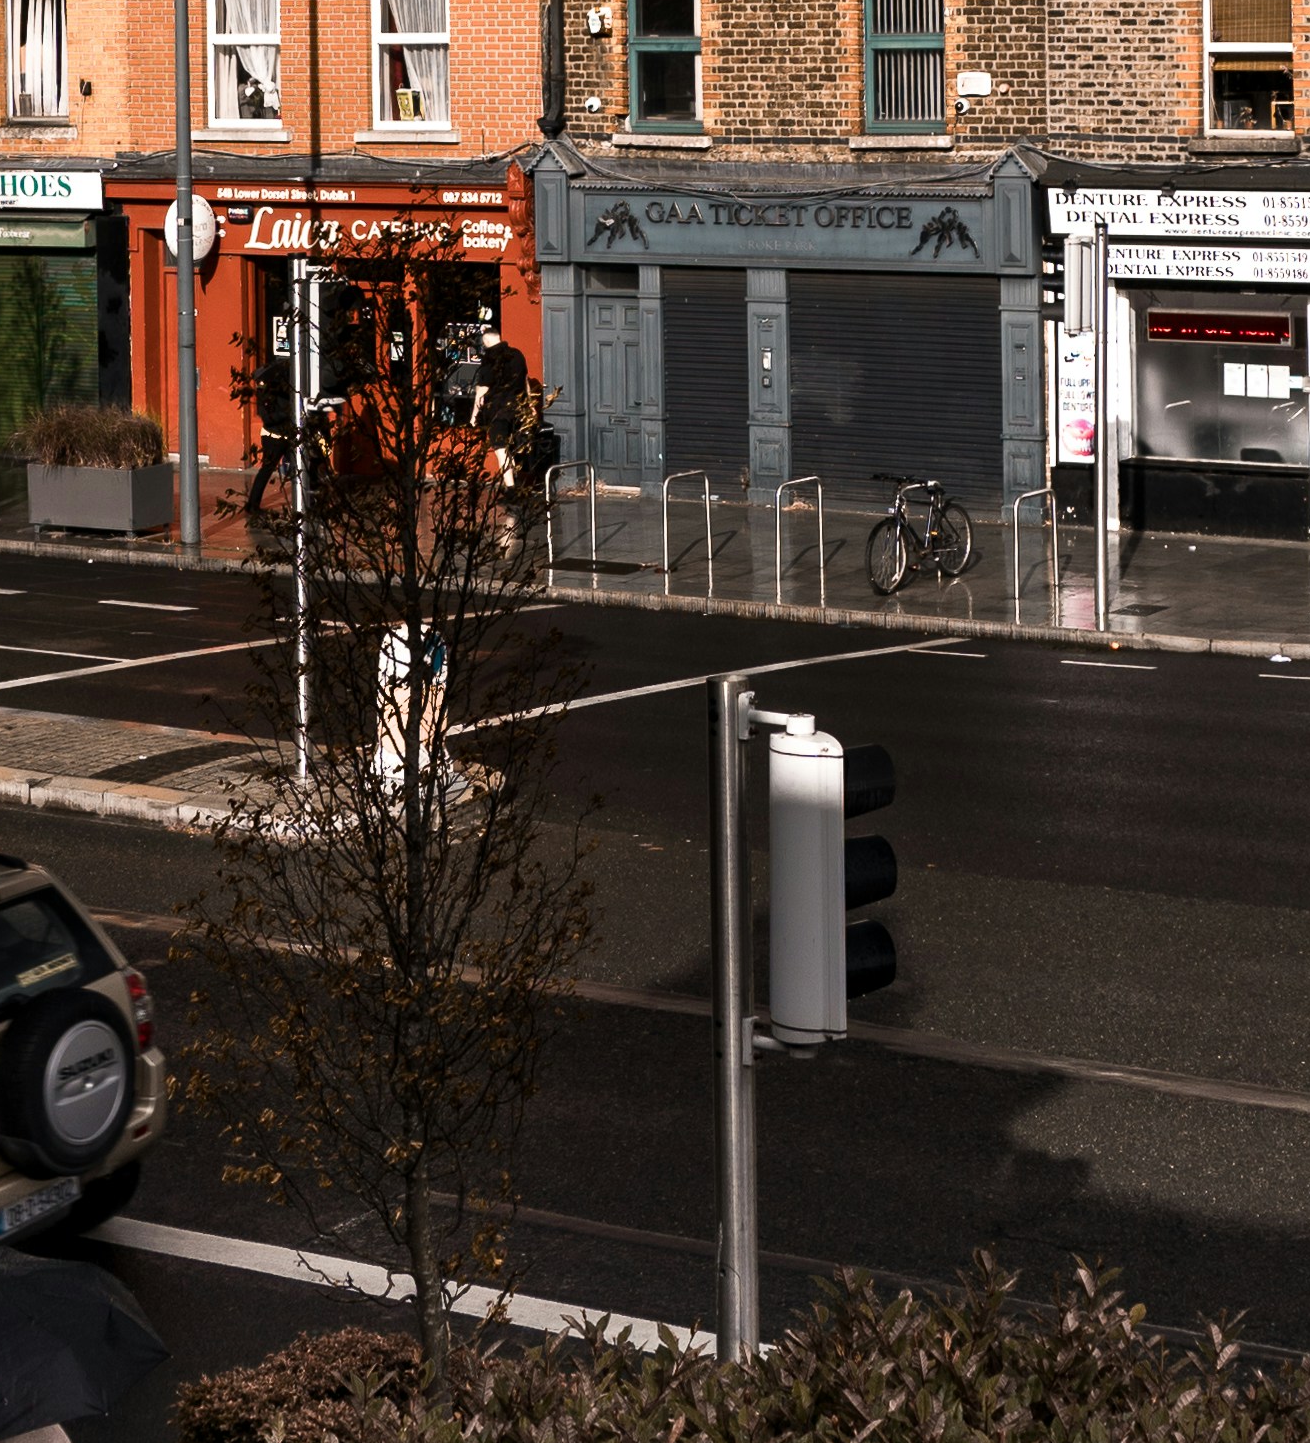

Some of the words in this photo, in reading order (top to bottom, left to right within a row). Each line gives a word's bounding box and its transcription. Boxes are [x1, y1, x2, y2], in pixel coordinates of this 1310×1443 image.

[234, 188, 260, 200] Lower
[261, 188, 289, 200] Dorset
[320, 189, 348, 201] Dublin
[350, 190, 356, 201] 1
[442, 192, 461, 204] 087
[461, 192, 478, 204] 334
[479, 193, 503, 204] 5712
[1055, 192, 1149, 207] DENTURE
[1156, 194, 1247, 209] EXPRESS
[644, 201, 706, 225] GAA
[708, 203, 809, 228] TICKET
[813, 204, 914, 230] OFFICE
[1066, 210, 1144, 225] DENTAL
[1149, 212, 1240, 227] EXPRESS
[462, 219, 505, 234] Coffee
[462, 234, 509, 252] bakery
[1108, 248, 1166, 260] ENTURE
[1172, 249, 1242, 262] EXPRESS
[1166, 265, 1235, 277] EXPRESS
[57, 1047, 115, 1081] SUZUKI
